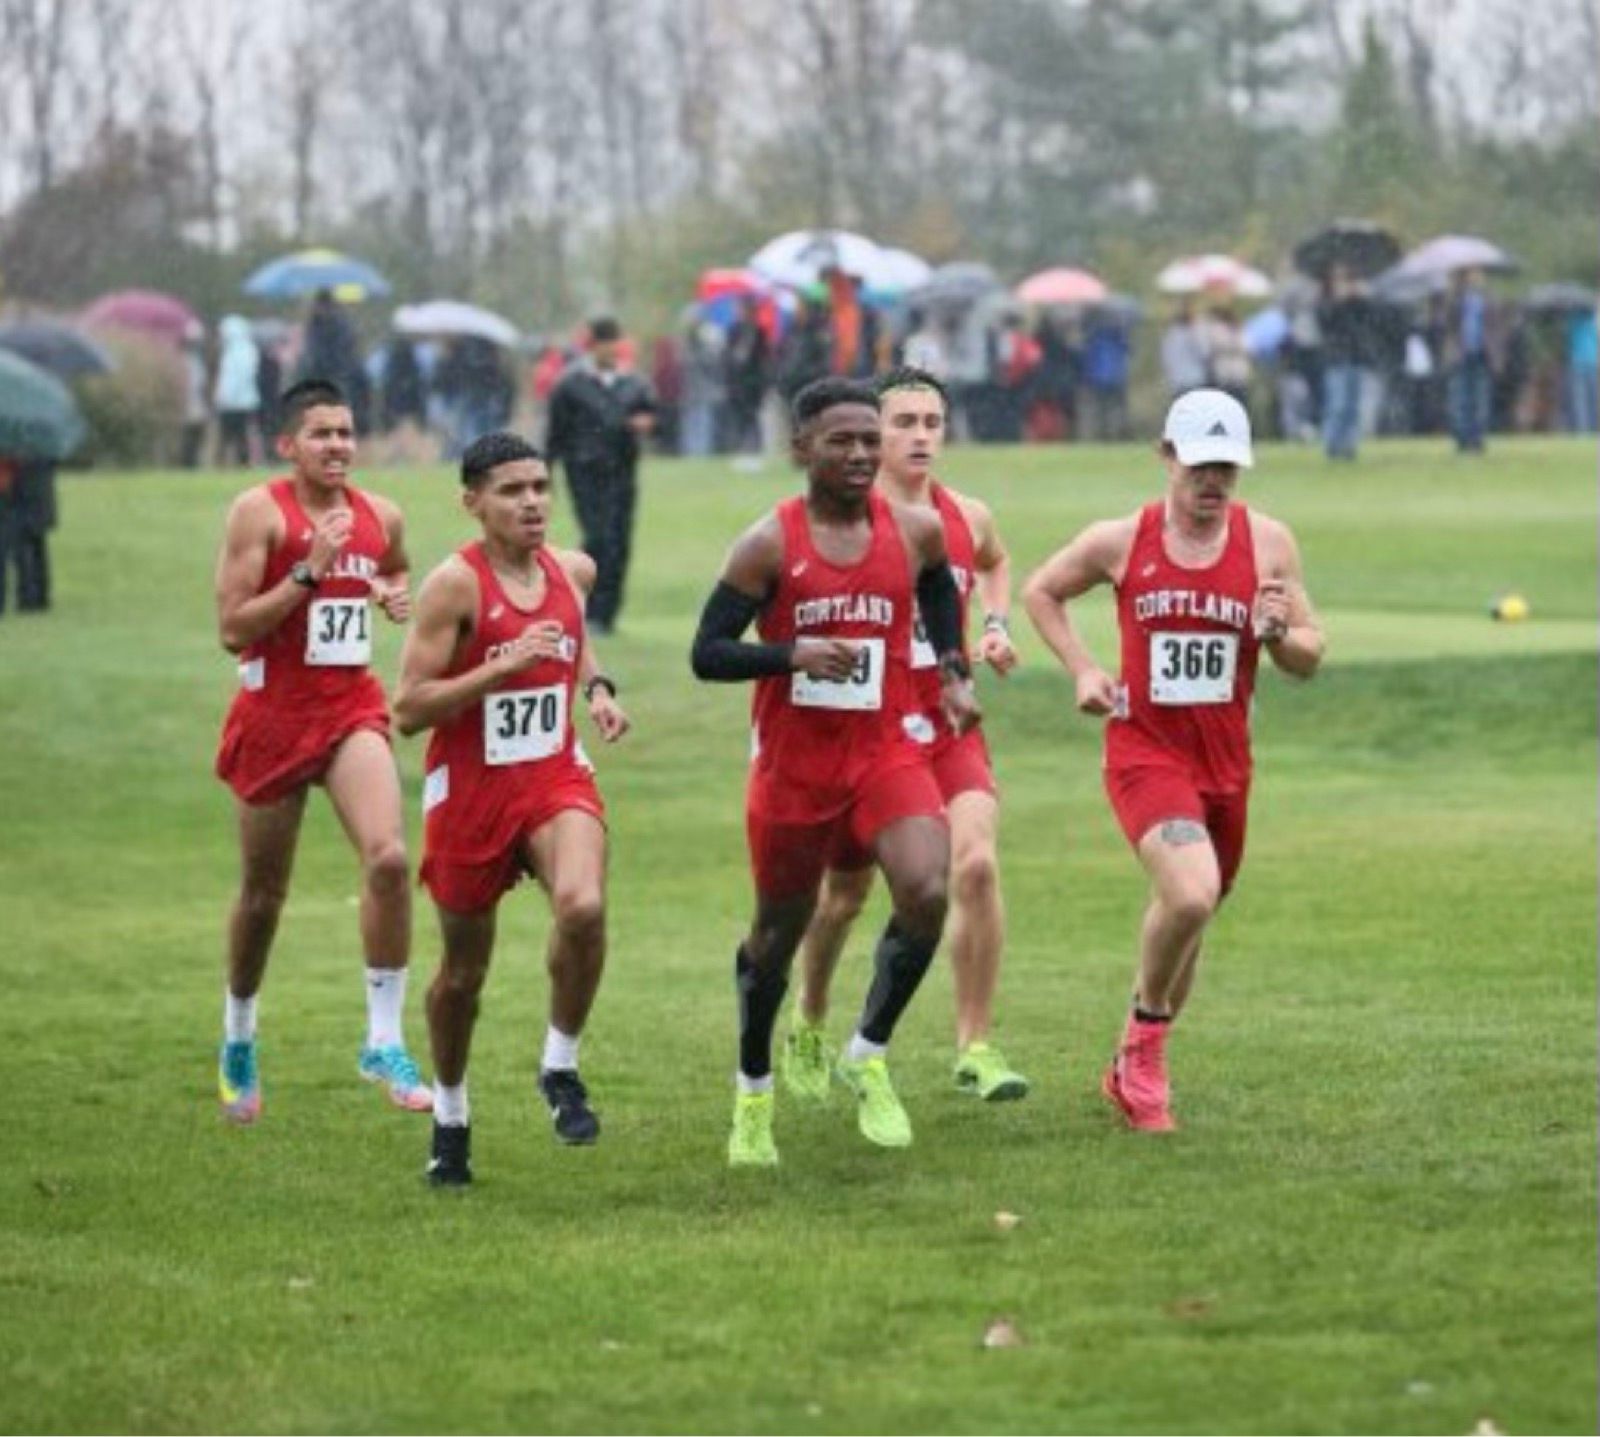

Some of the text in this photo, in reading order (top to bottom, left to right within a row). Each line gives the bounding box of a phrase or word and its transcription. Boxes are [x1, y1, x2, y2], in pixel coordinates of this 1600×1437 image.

[318, 604, 367, 643] 371
[795, 593, 893, 628] CORTLAND
[1135, 589, 1249, 629] CORTLAND
[1161, 638, 1226, 681] 366
[496, 693, 557, 739] 370
